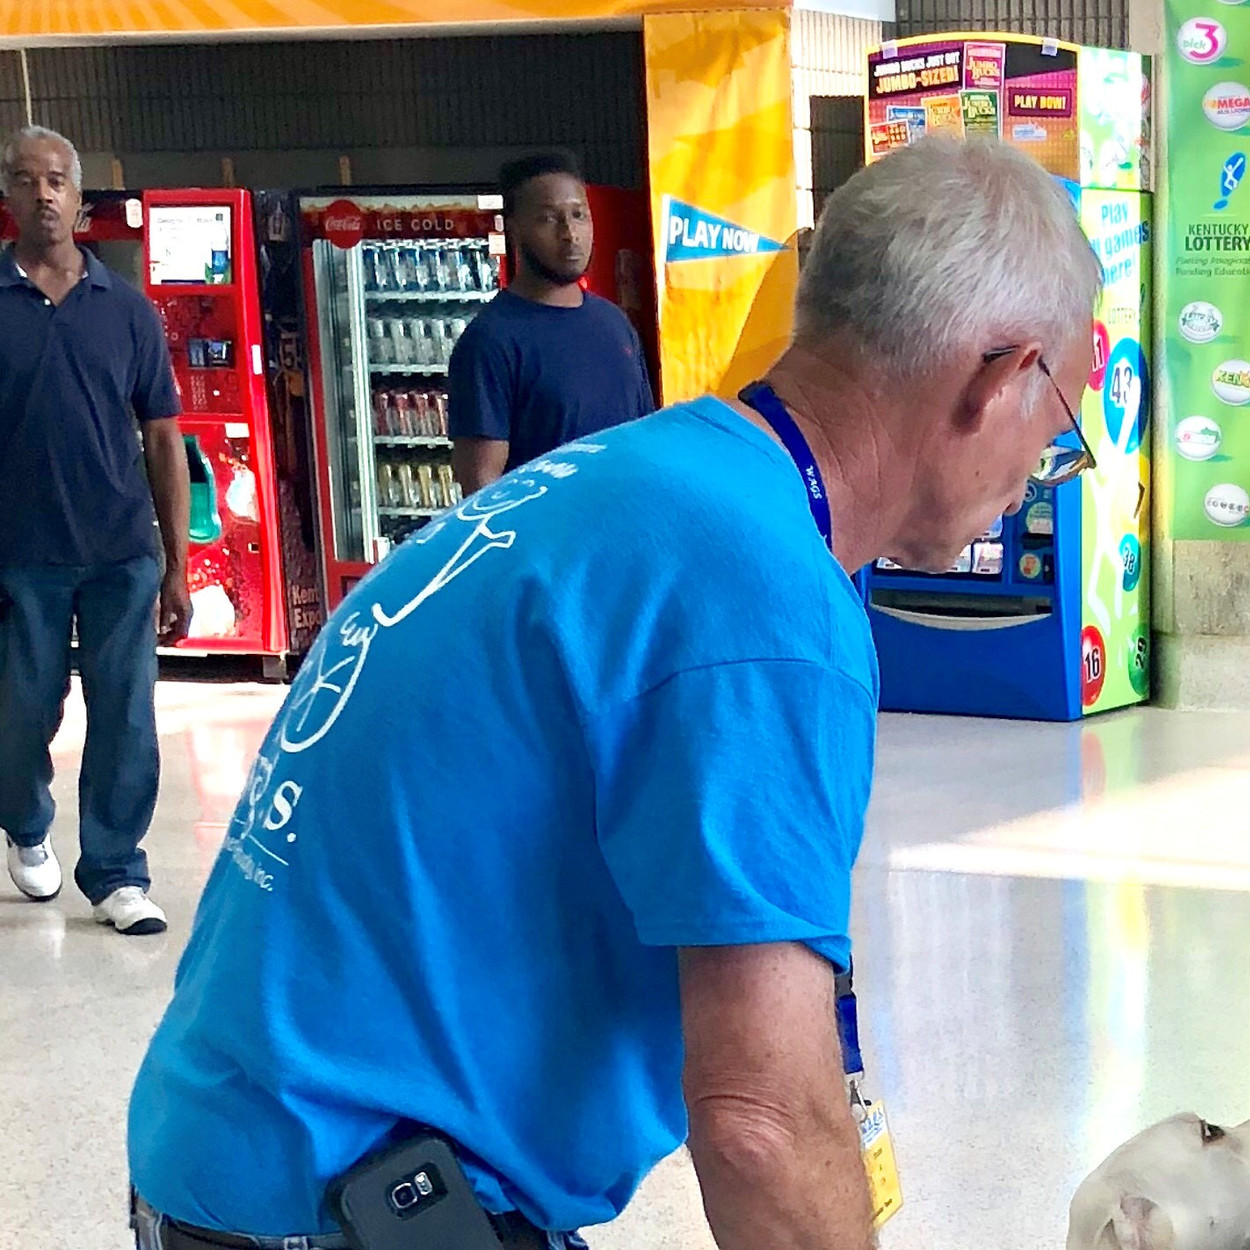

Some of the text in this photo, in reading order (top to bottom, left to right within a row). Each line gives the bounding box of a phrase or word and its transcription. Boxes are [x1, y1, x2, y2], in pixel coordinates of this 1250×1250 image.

[1189, 23, 1219, 59] 3
[1014, 94, 1037, 108] PLAY
[1217, 97, 1250, 109] MEGA
[376, 218, 455, 231] ICE COLD
[1101, 202, 1129, 225] Play
[669, 215, 760, 253] PLAY NOW
[1104, 219, 1150, 258] games
[1188, 223, 1249, 236] KENTUCKY
[805, 465, 823, 499] WAGS
[1085, 647, 1101, 683] 16
